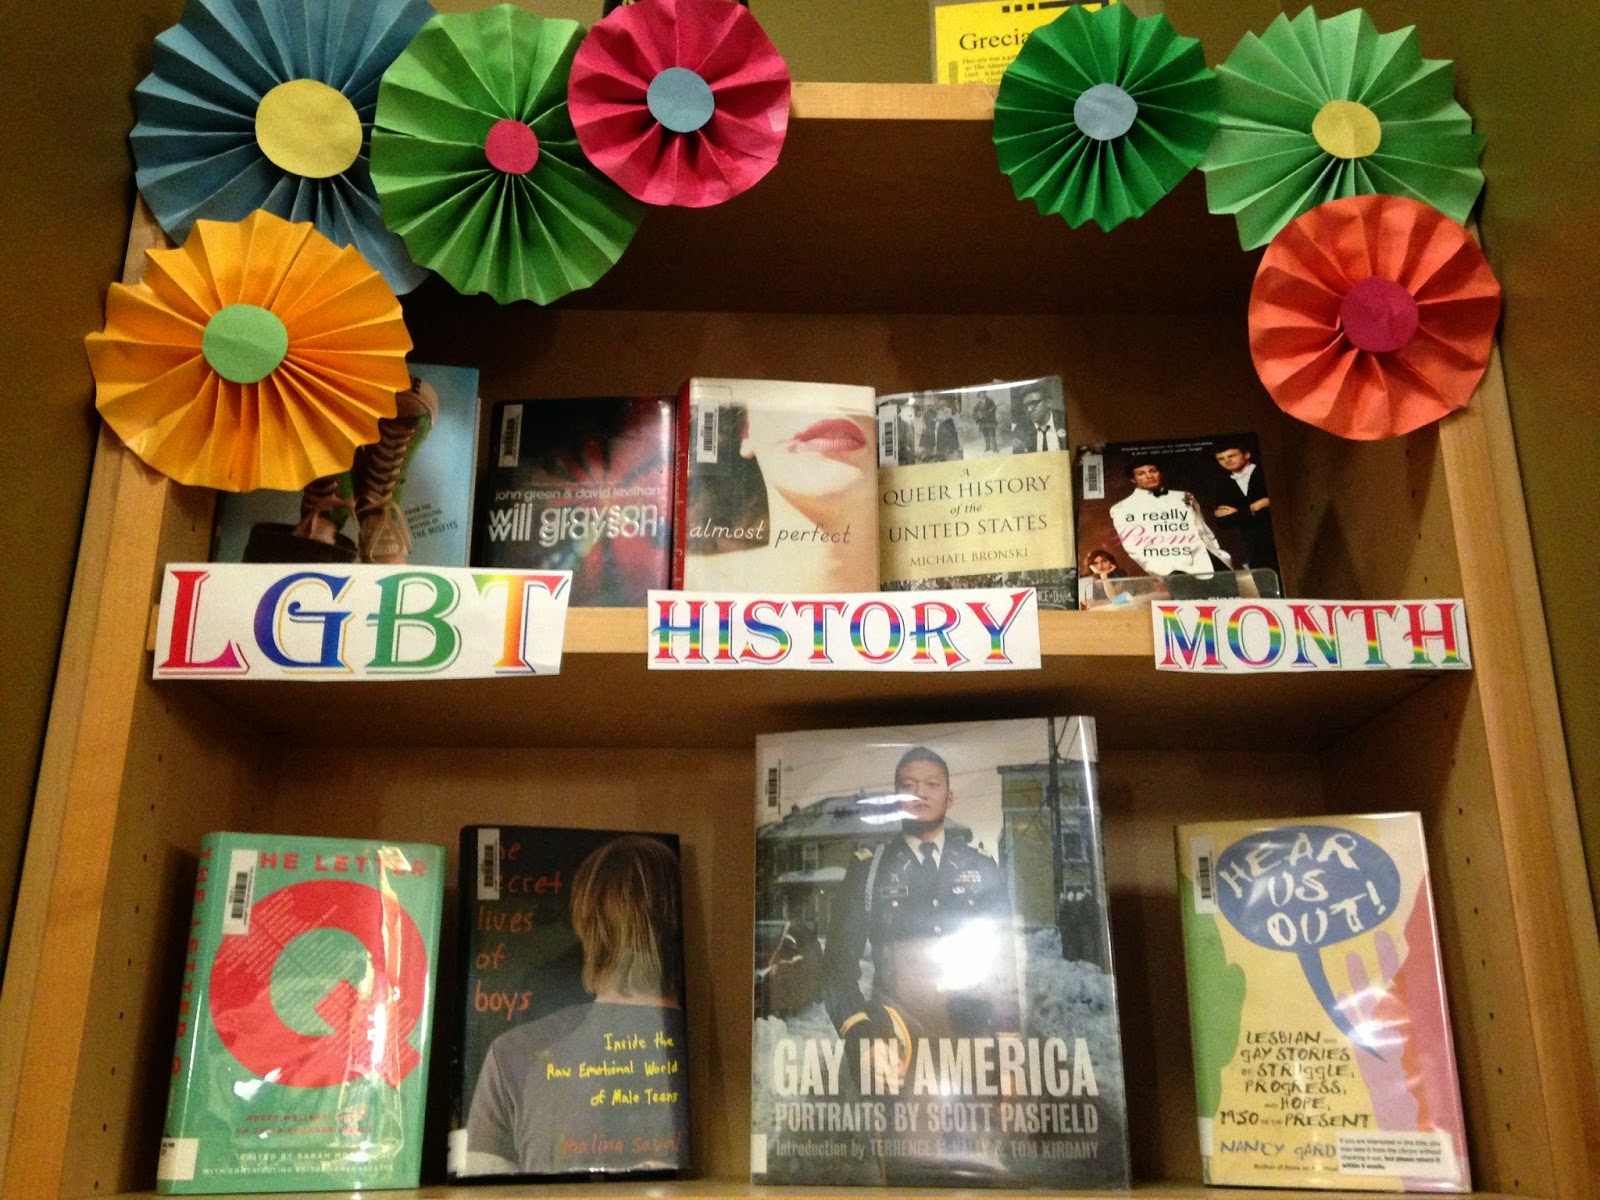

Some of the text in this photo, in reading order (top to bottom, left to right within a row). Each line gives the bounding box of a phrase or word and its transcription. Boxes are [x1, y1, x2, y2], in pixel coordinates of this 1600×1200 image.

[960, 468, 970, 477] A
[495, 489, 521, 502] john
[524, 490, 561, 502] green
[575, 487, 610, 499] david
[613, 486, 661, 498] levithan
[883, 475, 1050, 507] QUEER HISTORY
[950, 504, 982, 516] of the
[1125, 509, 1188, 524] a really
[689, 518, 850, 548] almost perfect
[889, 514, 1048, 543] UNITED STATES
[1113, 525, 1197, 547] Prom
[1154, 521, 1190, 533] nice
[910, 548, 1028, 567] MICHAEL BRONSKI
[1143, 546, 1192, 557] mess
[158, 570, 569, 675] LGBT
[651, 589, 1033, 670] HISTORY
[1157, 603, 1469, 670] MONTH
[260, 851, 299, 871] HE
[1219, 832, 1360, 899] HEAR
[499, 870, 562, 895] cret
[1267, 869, 1328, 907] US
[477, 905, 534, 933] lives
[1267, 880, 1386, 947] OUT!
[475, 944, 504, 970] of
[474, 979, 533, 1021] boys
[604, 1031, 674, 1051] Inside the
[1246, 1030, 1321, 1044] LESBIAN
[1276, 1047, 1350, 1061] STORIES
[547, 1060, 677, 1080] Raw Emotional World
[774, 1037, 1099, 1097] GAY IN AMERICA
[590, 1088, 678, 1106] of Male Teens
[1281, 1096, 1331, 1111] HOPE,
[774, 1102, 1099, 1133] PORTRAITS BY SCOTT PASFIELD
[1219, 1110, 1259, 1125] 1950
[1285, 1112, 1370, 1128] PRESENT
[776, 1139, 847, 1157] Introduction
[851, 1140, 865, 1160] by
[1010, 1141, 1038, 1158] TOM
[1219, 1140, 1285, 1156] NANCY
